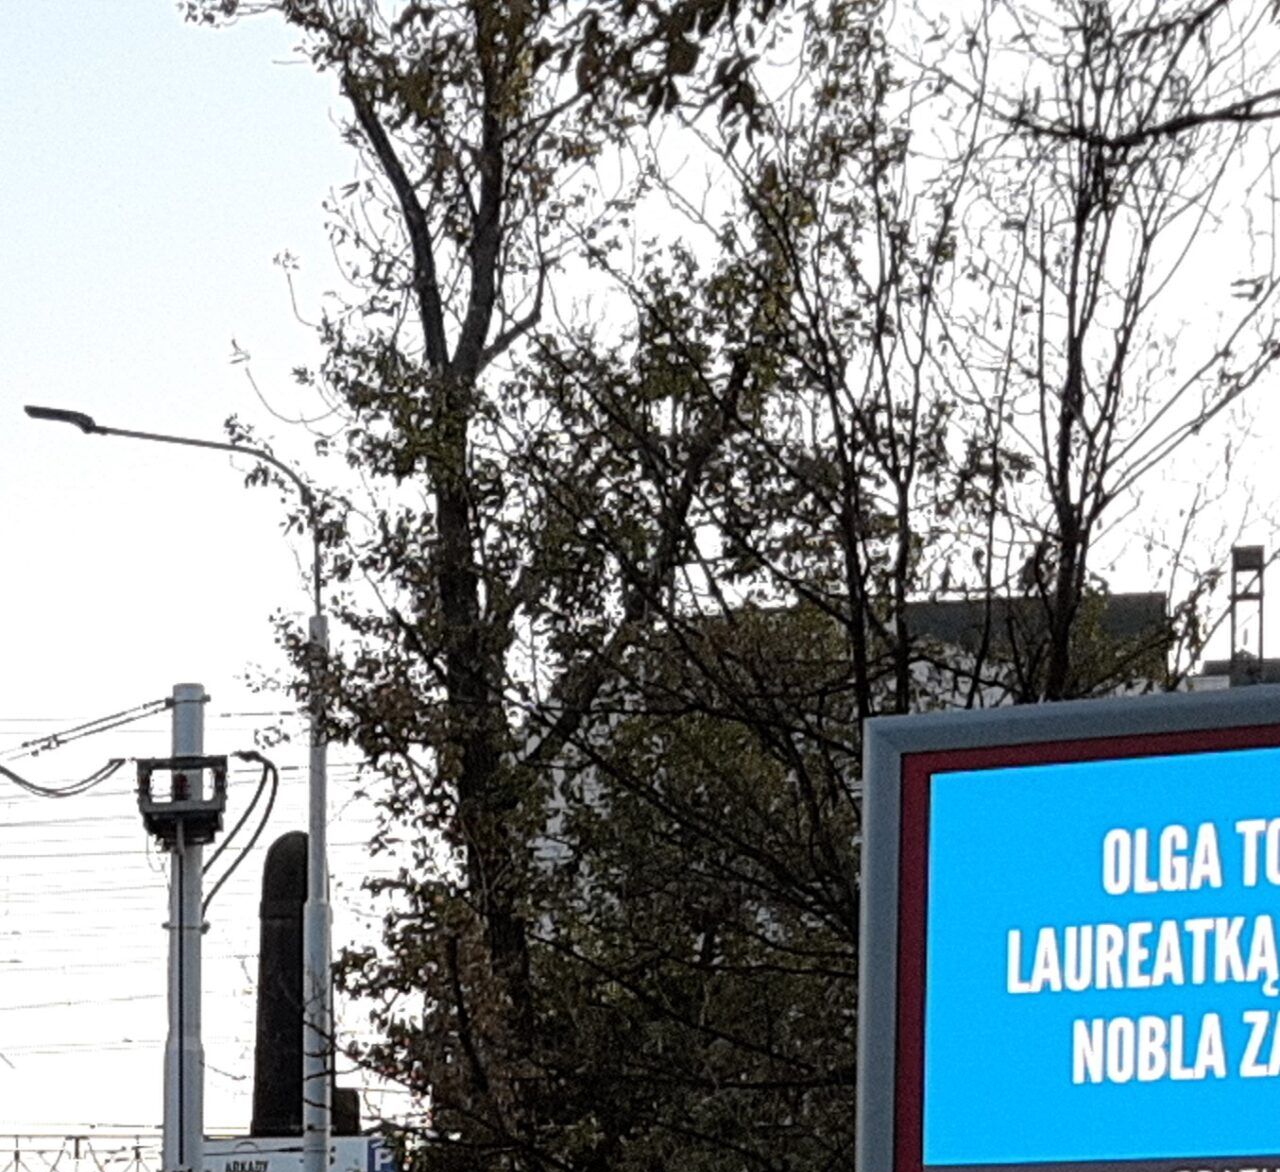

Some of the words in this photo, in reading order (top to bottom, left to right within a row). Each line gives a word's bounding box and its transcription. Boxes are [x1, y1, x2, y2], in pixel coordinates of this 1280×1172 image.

[1102, 821, 1222, 896] OLGA
[1007, 915, 1280, 997] LAUREATKĄ
[1073, 1013, 1227, 1084] NOBLA
